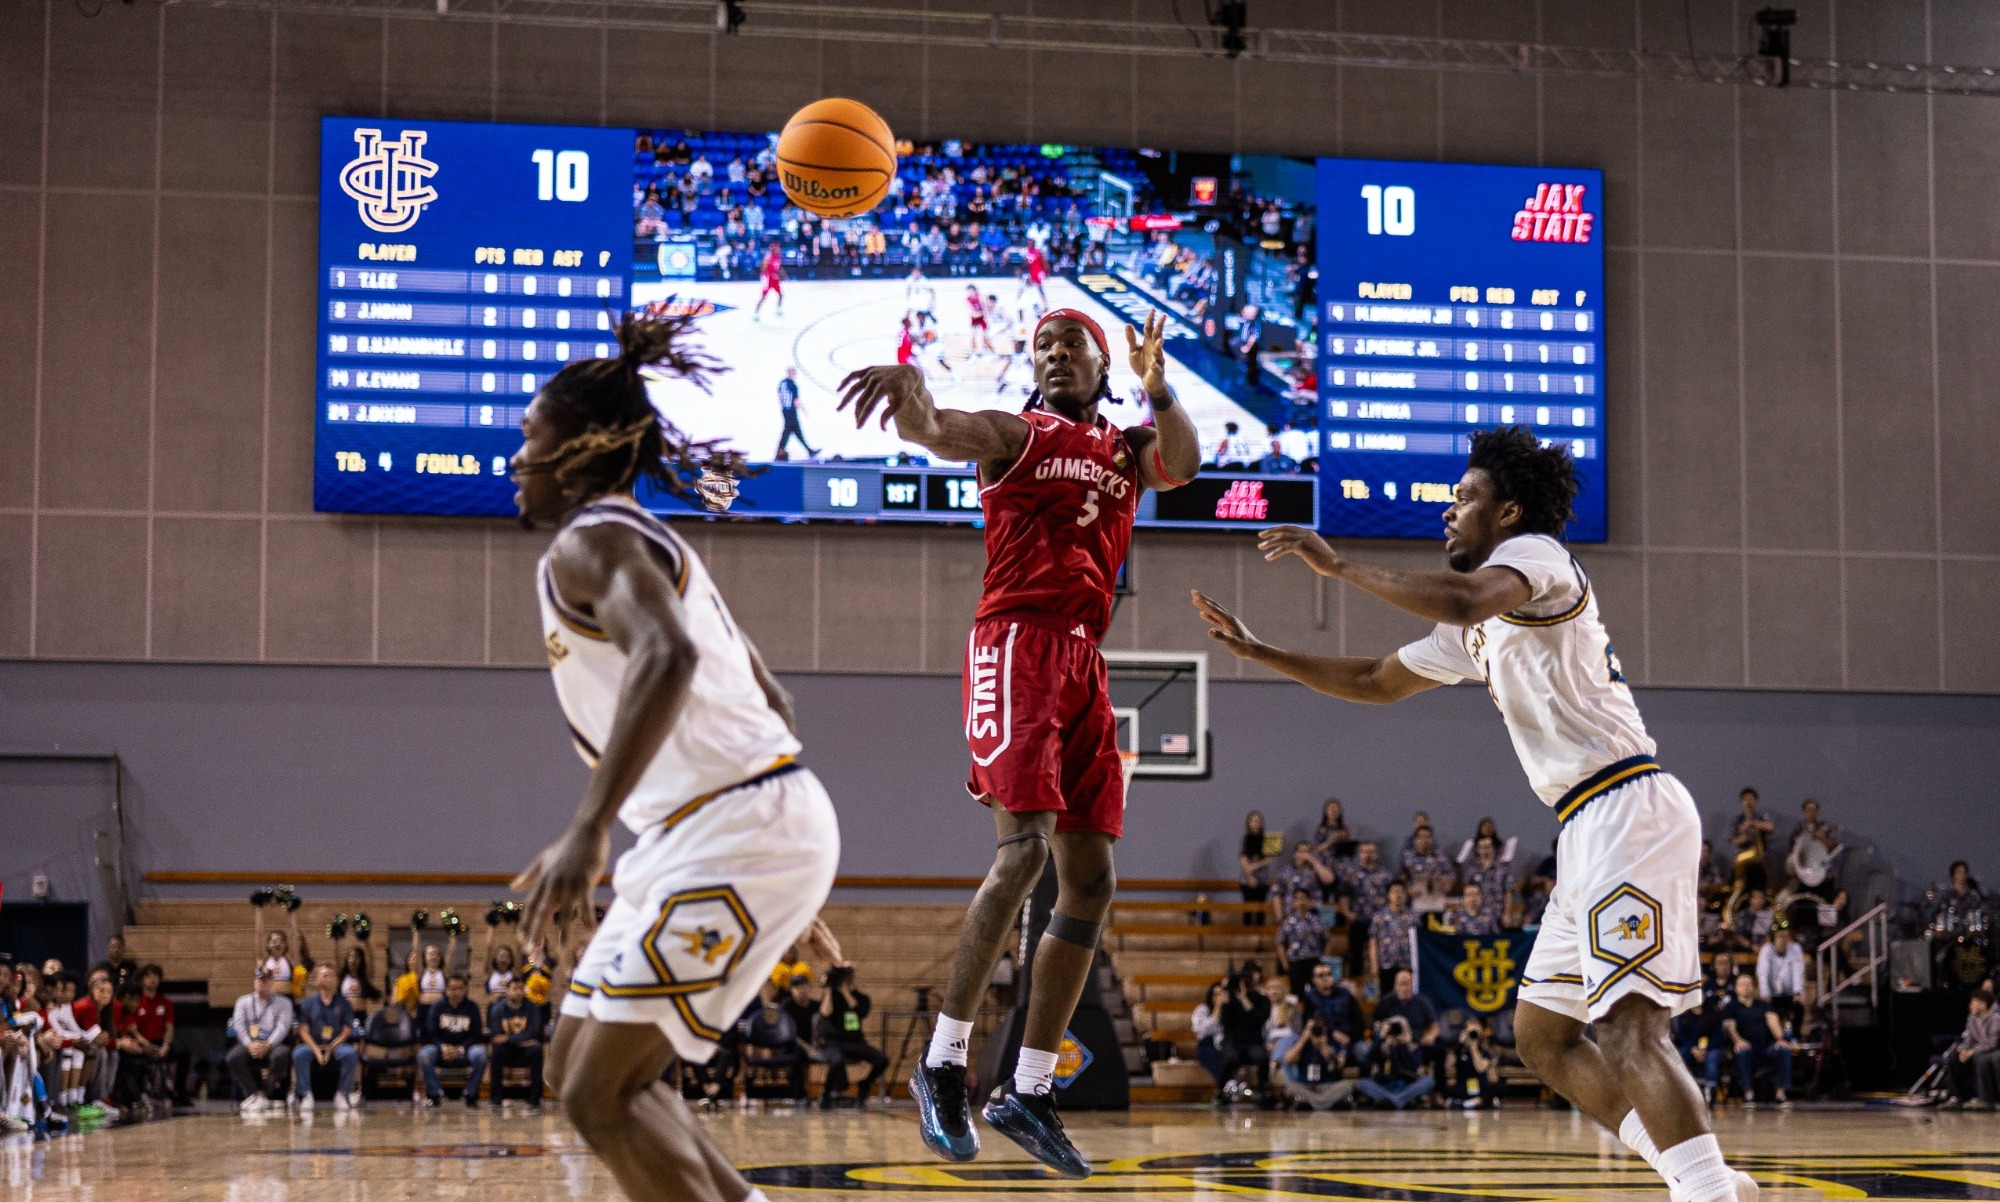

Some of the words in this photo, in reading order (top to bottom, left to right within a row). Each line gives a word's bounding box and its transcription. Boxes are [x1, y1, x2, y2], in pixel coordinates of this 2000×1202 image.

[531, 149, 589, 202] 10
[784, 169, 859, 199] Wilson
[1361, 185, 1415, 236] 10
[1525, 183, 1586, 212] JAX
[1511, 210, 1593, 243] STATE
[358, 243, 417, 261] PLAYER
[475, 247, 506, 265] PTS
[552, 250, 584, 267] AST
[599, 251, 611, 267] F
[1358, 282, 1413, 300] PLAYER
[1449, 286, 1479, 303] PTS
[1531, 289, 1560, 306] AST
[1575, 290, 1587, 307] F
[1502, 343, 1513, 362] 1
[1538, 344, 1549, 363] 1
[1503, 373, 1514, 392] 1
[1537, 374, 1549, 393] 1
[1573, 375, 1584, 394] 1
[377, 452, 392, 471] 4
[416, 453, 480, 475] FOULS:
[827, 477, 858, 507] 10
[946, 479, 980, 508] 13
[1224, 481, 1264, 500] JAX
[1076, 490, 1099, 528] 5
[1215, 499, 1269, 520] STATE
[972, 645, 999, 739] STATE
